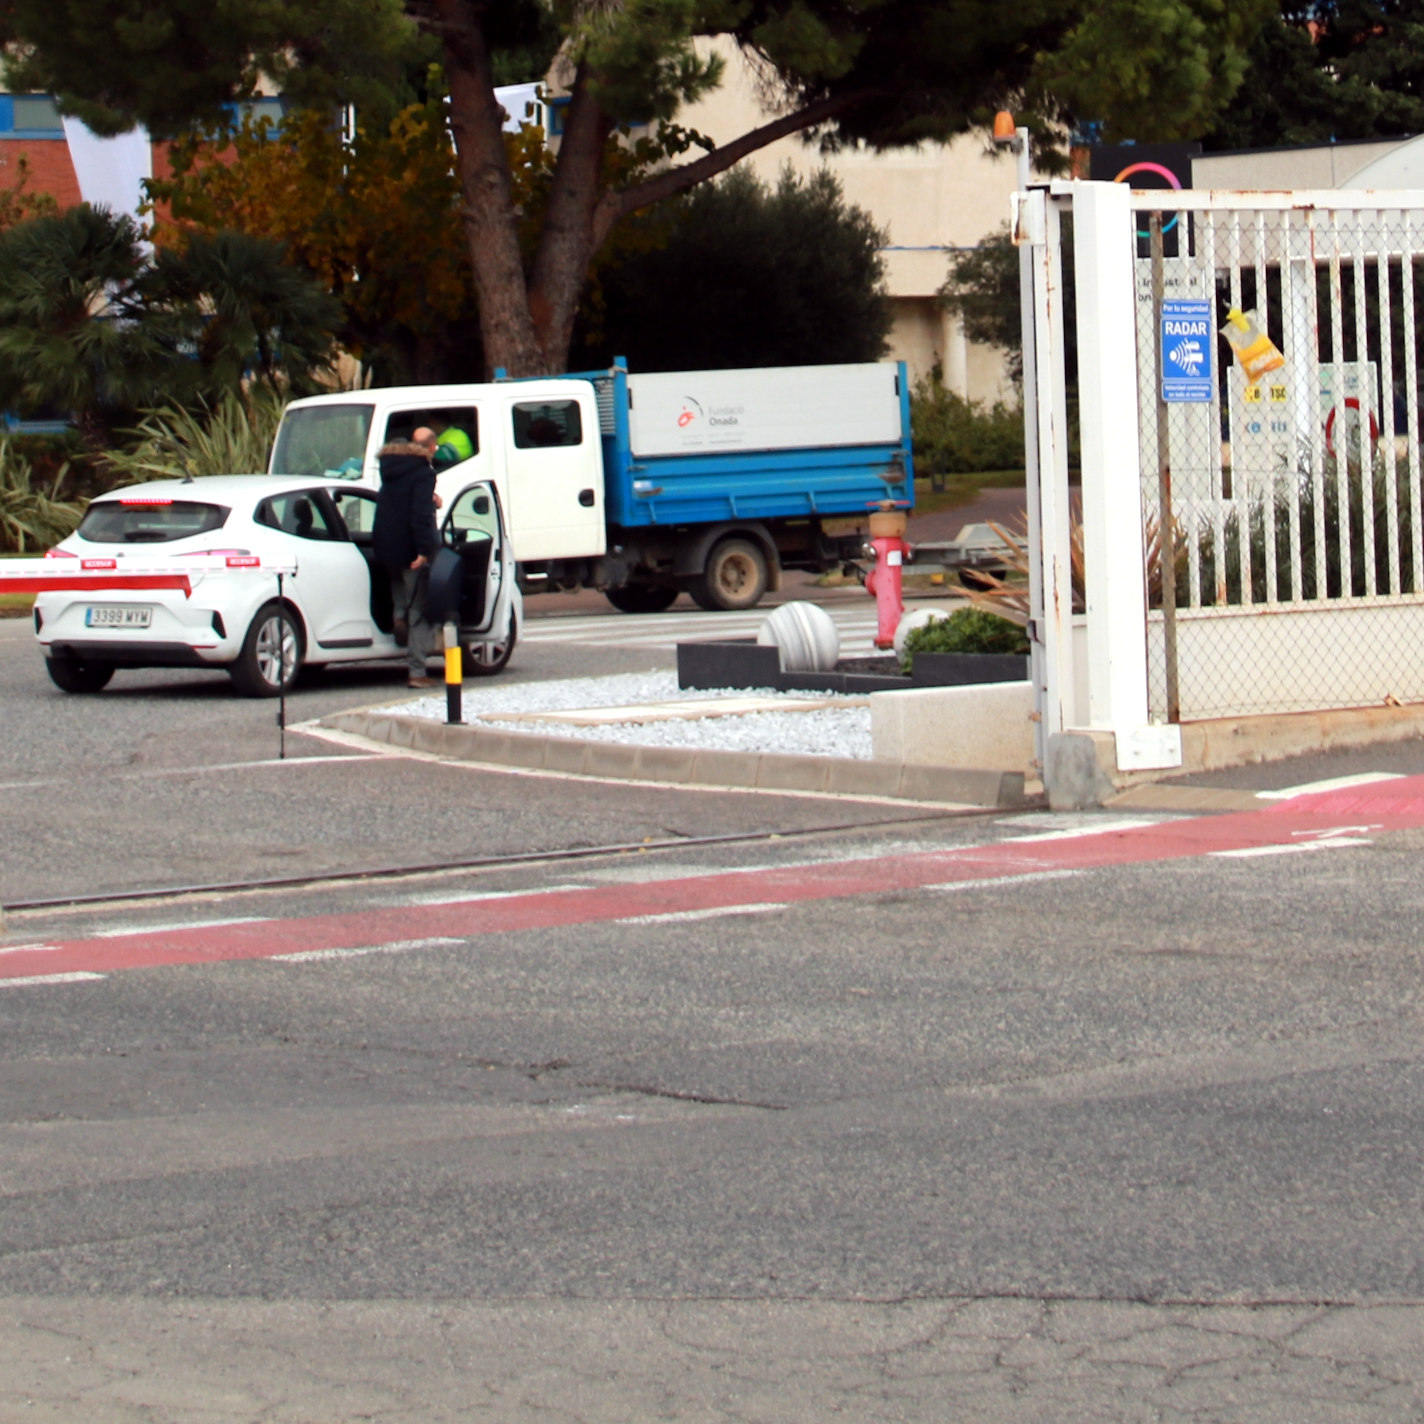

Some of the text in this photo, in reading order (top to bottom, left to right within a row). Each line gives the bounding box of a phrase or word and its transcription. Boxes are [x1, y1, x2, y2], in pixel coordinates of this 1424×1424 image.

[1163, 304, 1173, 312] Por
[1180, 304, 1209, 314] seguridad
[1165, 321, 1207, 336] RADAR
[709, 416, 738, 426] Onada
[94, 609, 122, 623] 3399
